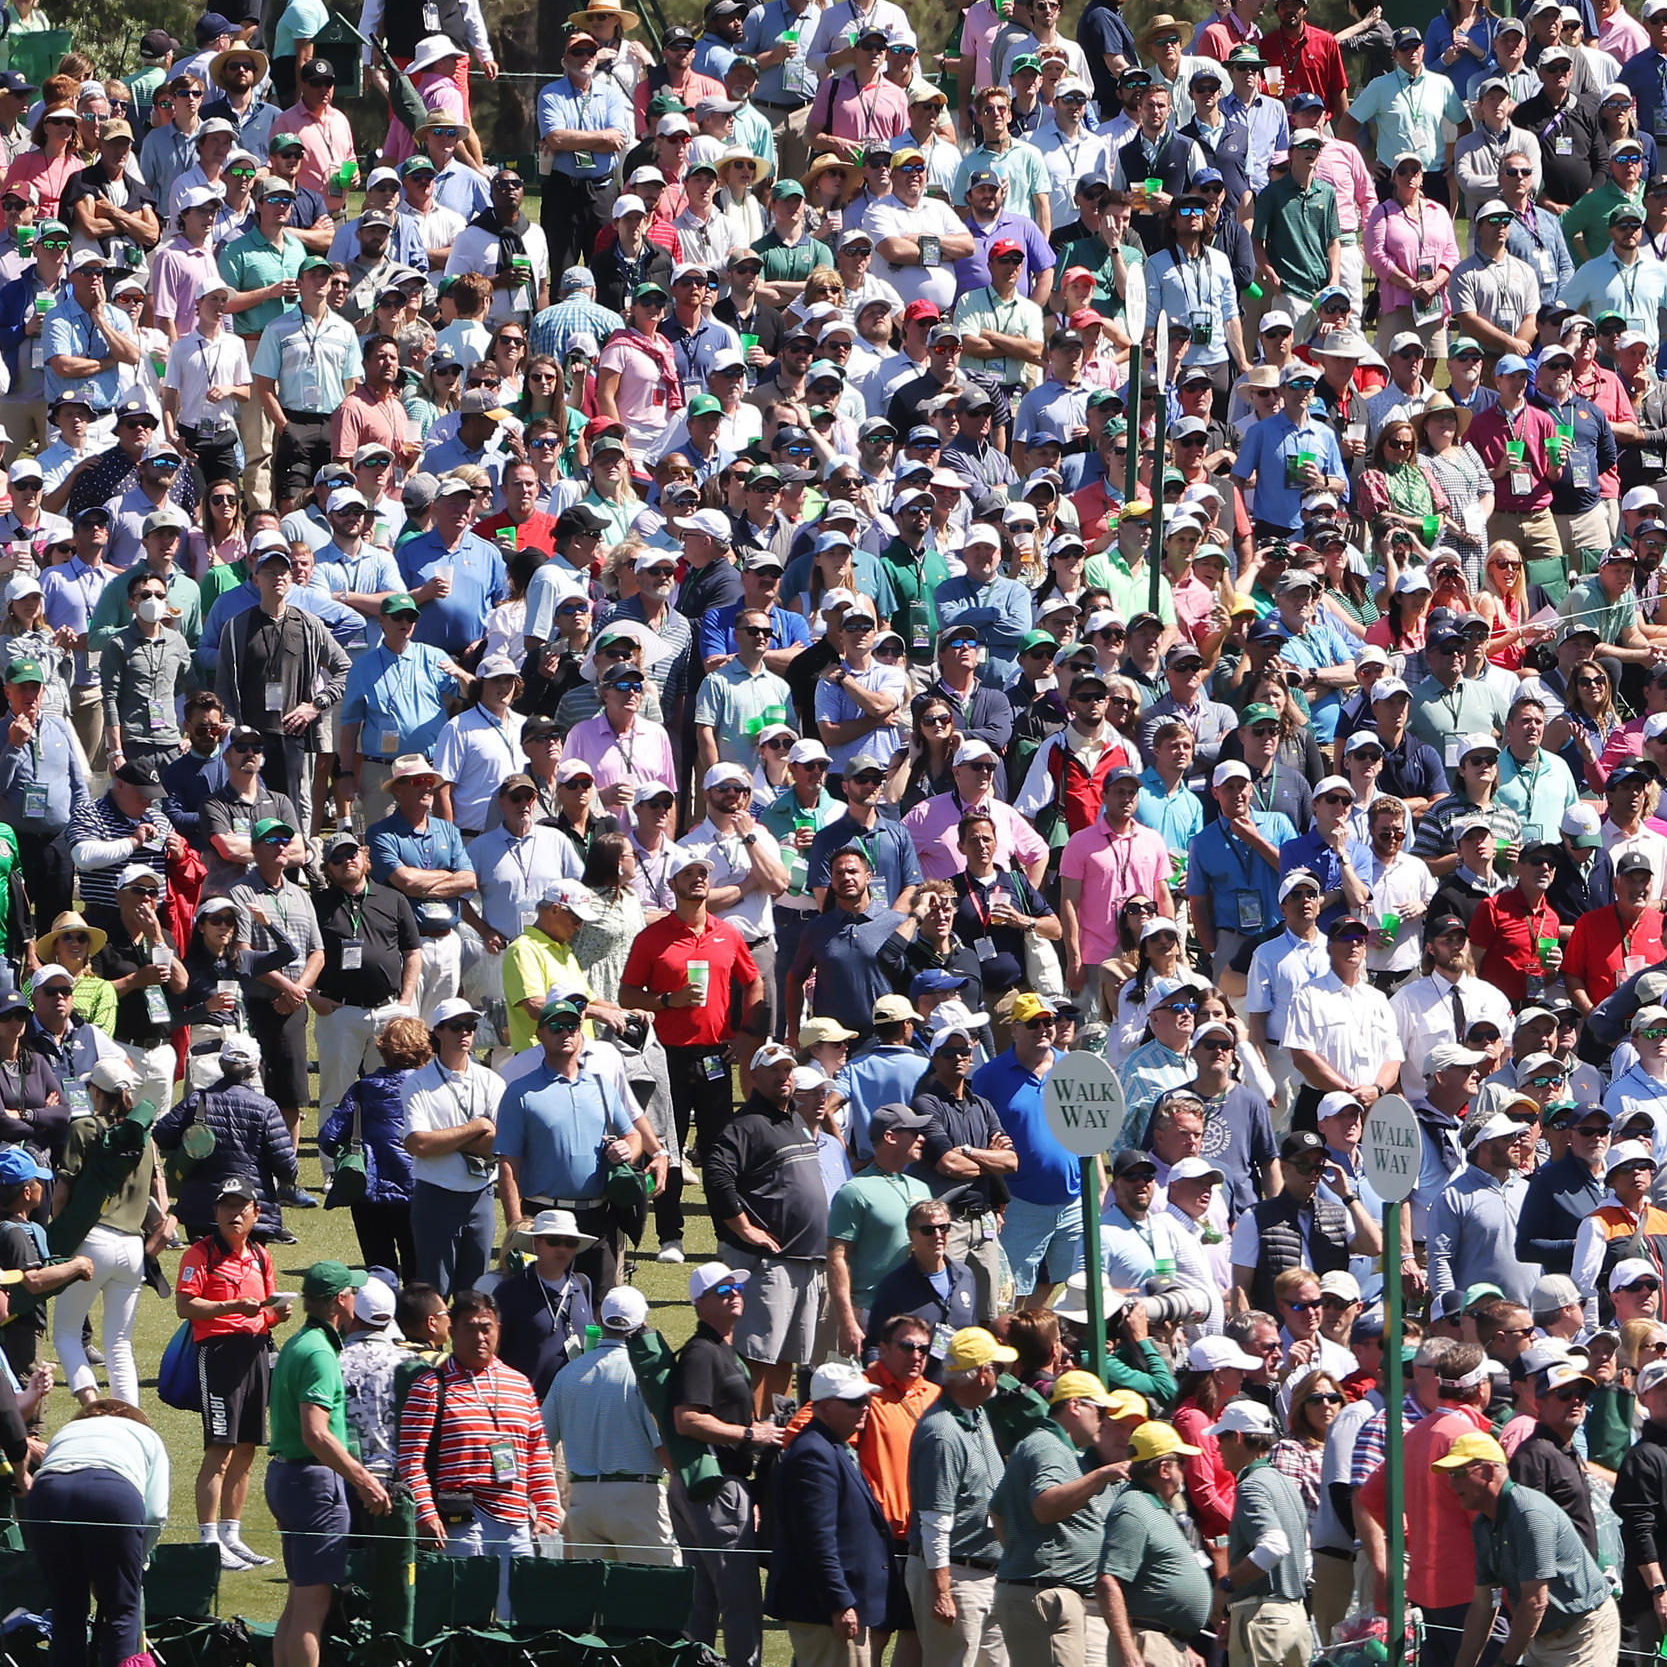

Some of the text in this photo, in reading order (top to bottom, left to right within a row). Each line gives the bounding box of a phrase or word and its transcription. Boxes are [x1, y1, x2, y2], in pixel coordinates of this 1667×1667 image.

[1052, 1078, 1116, 1102] WALK
[1059, 1105, 1110, 1129] WAY
[1370, 1120, 1415, 1148] WALK
[1373, 1147, 1410, 1175] WAY
[209, 1392, 229, 1436] JAPAN
